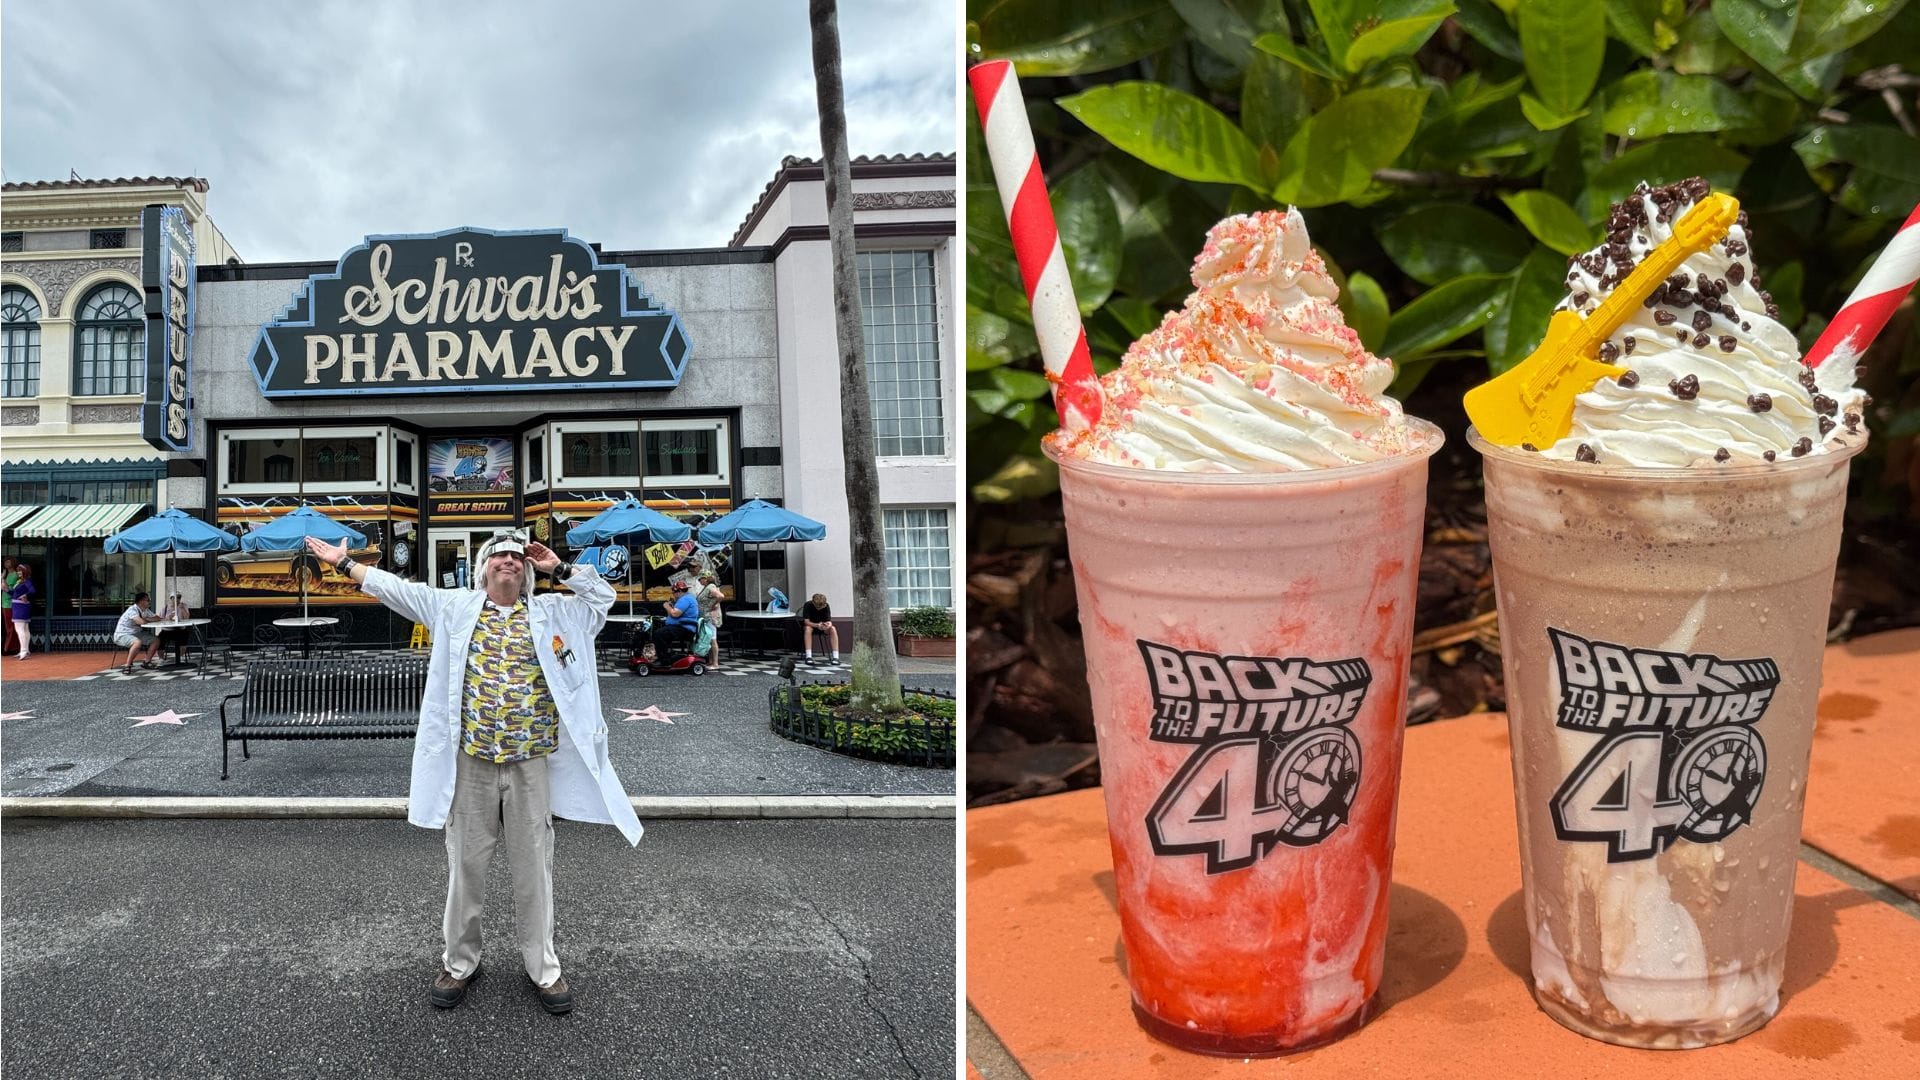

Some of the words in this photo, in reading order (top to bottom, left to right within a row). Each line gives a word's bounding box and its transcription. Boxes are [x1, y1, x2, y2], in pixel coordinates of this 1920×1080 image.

[338, 242, 603, 326] Schwab's
[168, 252, 188, 441] DRUGS
[303, 325, 638, 385] PHARMACY
[437, 502, 470, 512] GREAT
[471, 502, 507, 511] SCOTT!
[1144, 643, 1336, 702] BACK
[1555, 633, 1745, 696] BACK
[1159, 697, 1193, 721] TO
[1191, 688, 1366, 739] FUTURE
[1563, 706, 1600, 727] THE
[1567, 686, 1600, 710] TO
[1597, 687, 1773, 729] FUTURE
[1156, 718, 1193, 738] THE
[1145, 726, 1362, 875] 40
[1549, 724, 1767, 863] 40
